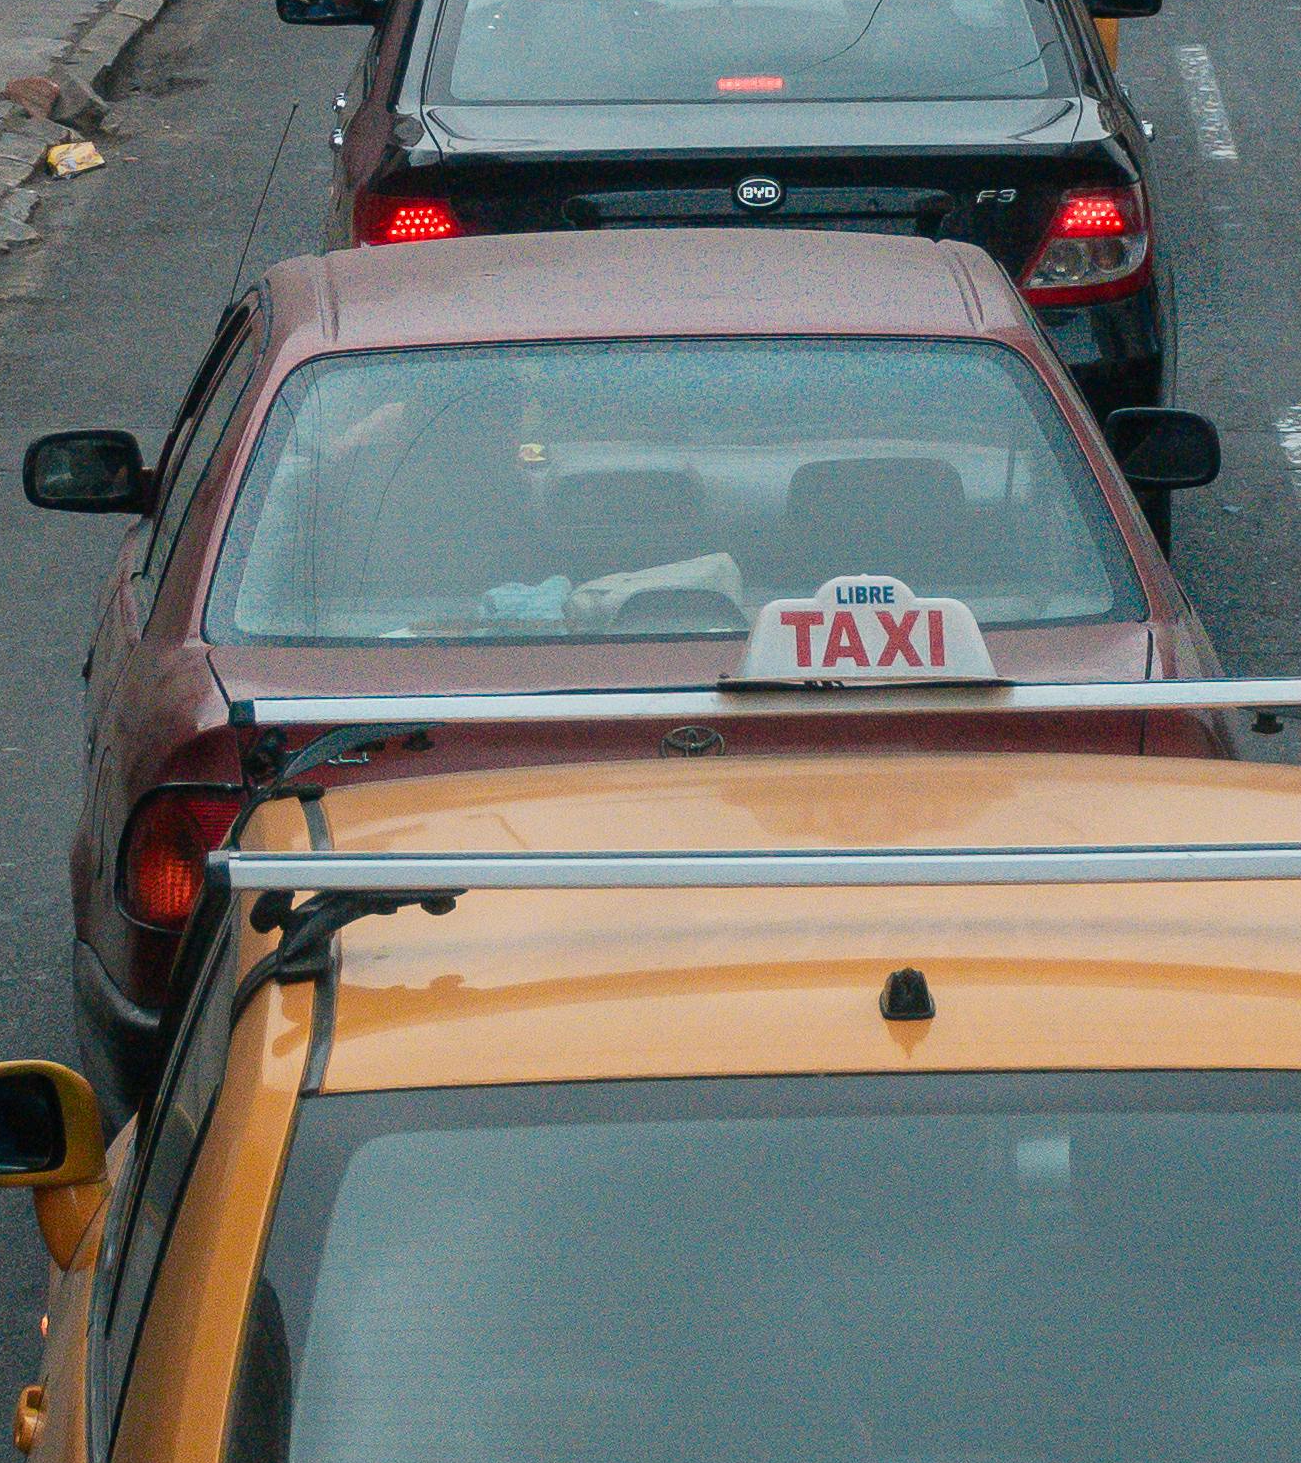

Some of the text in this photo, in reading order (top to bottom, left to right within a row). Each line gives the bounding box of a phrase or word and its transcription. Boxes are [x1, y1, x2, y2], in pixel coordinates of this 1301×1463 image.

[742, 186, 776, 199] BYD
[976, 189, 1017, 204] F3
[835, 585, 896, 605] LIBRE
[780, 609, 946, 668] TAXI
